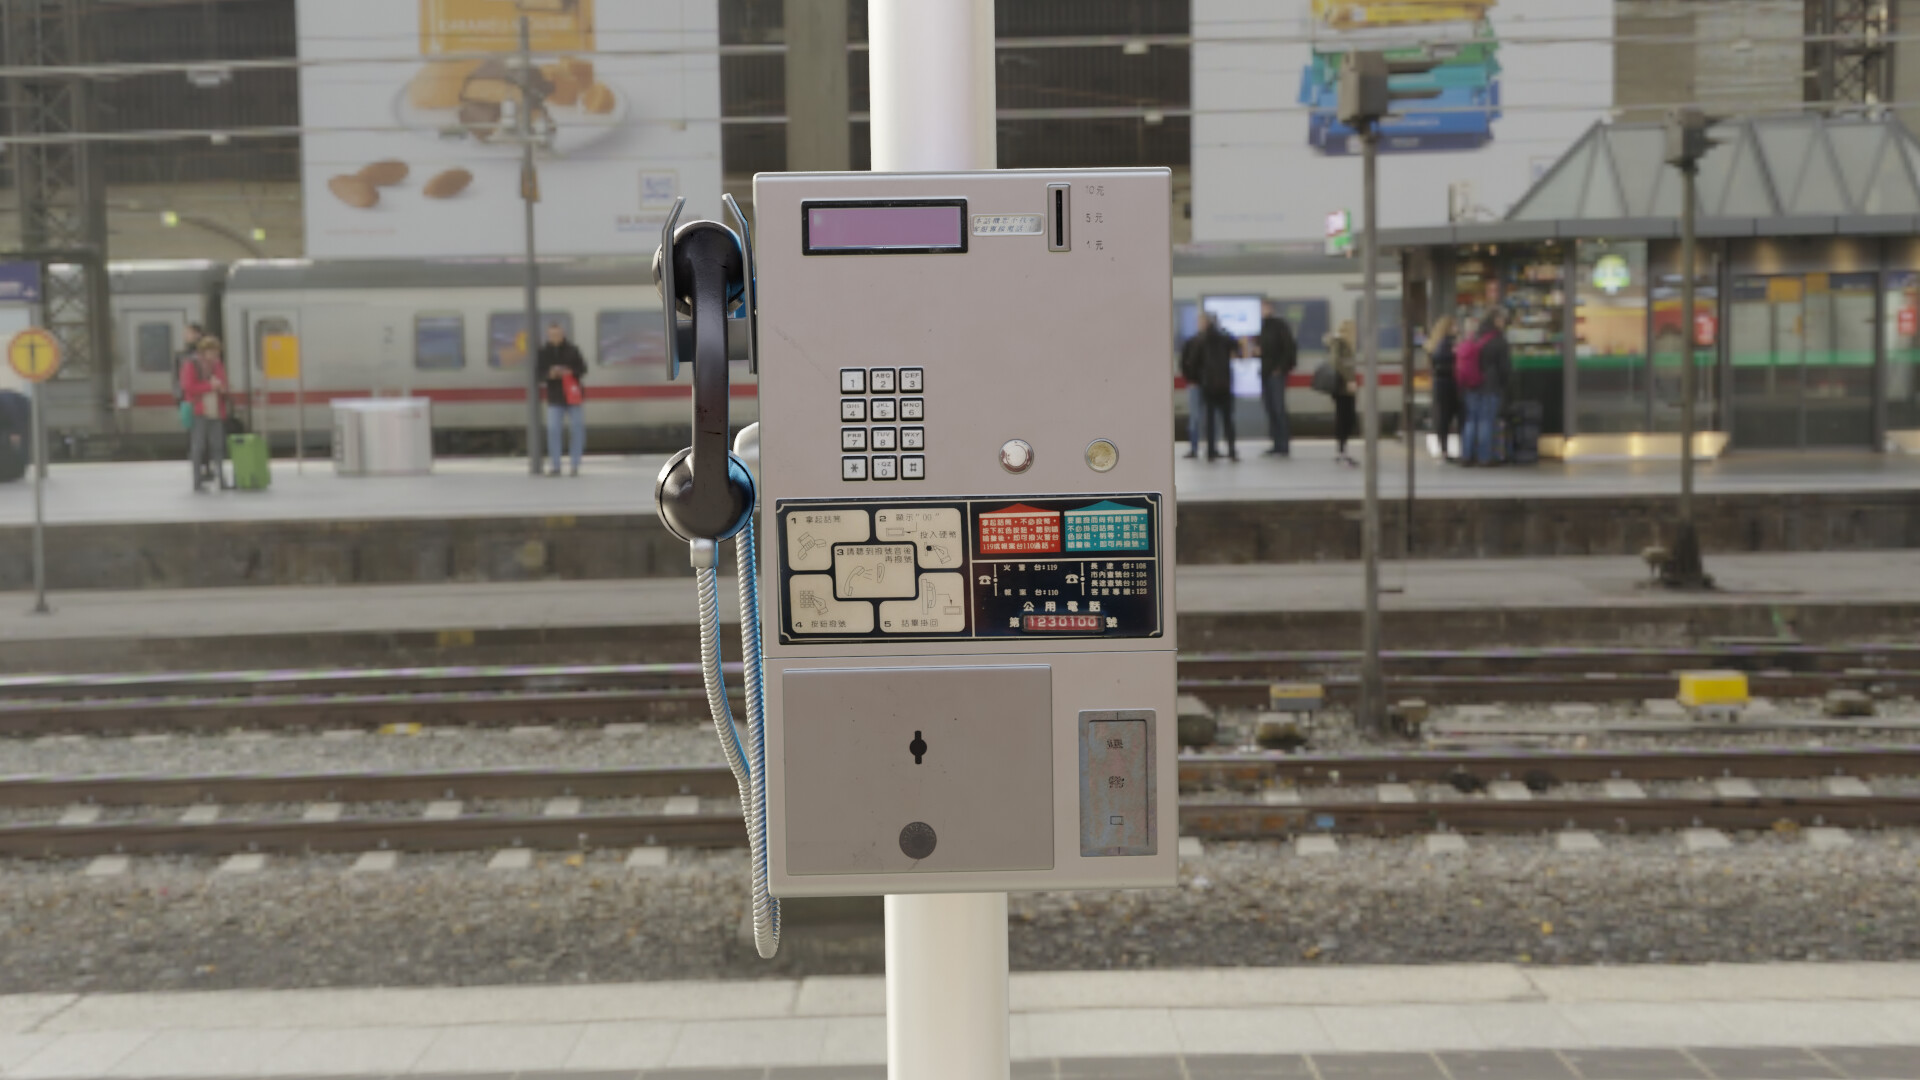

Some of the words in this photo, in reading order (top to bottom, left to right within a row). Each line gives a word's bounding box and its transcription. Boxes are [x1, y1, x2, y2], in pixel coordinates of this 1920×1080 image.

[850, 379, 855, 388] 1
[880, 380, 887, 388] 2
[909, 380, 916, 388] 3
[880, 409, 887, 417] 5
[852, 439, 858, 447] 7
[880, 439, 886, 447] 8
[881, 469, 888, 477] 0
[920, 531, 957, 540] 投入硬幣
[1022, 600, 1101, 613] 公用電話
[884, 620, 892, 628] 5
[1009, 617, 1020, 628] 第
[1029, 615, 1097, 627] 1230100
[1106, 616, 1118, 628] 號
